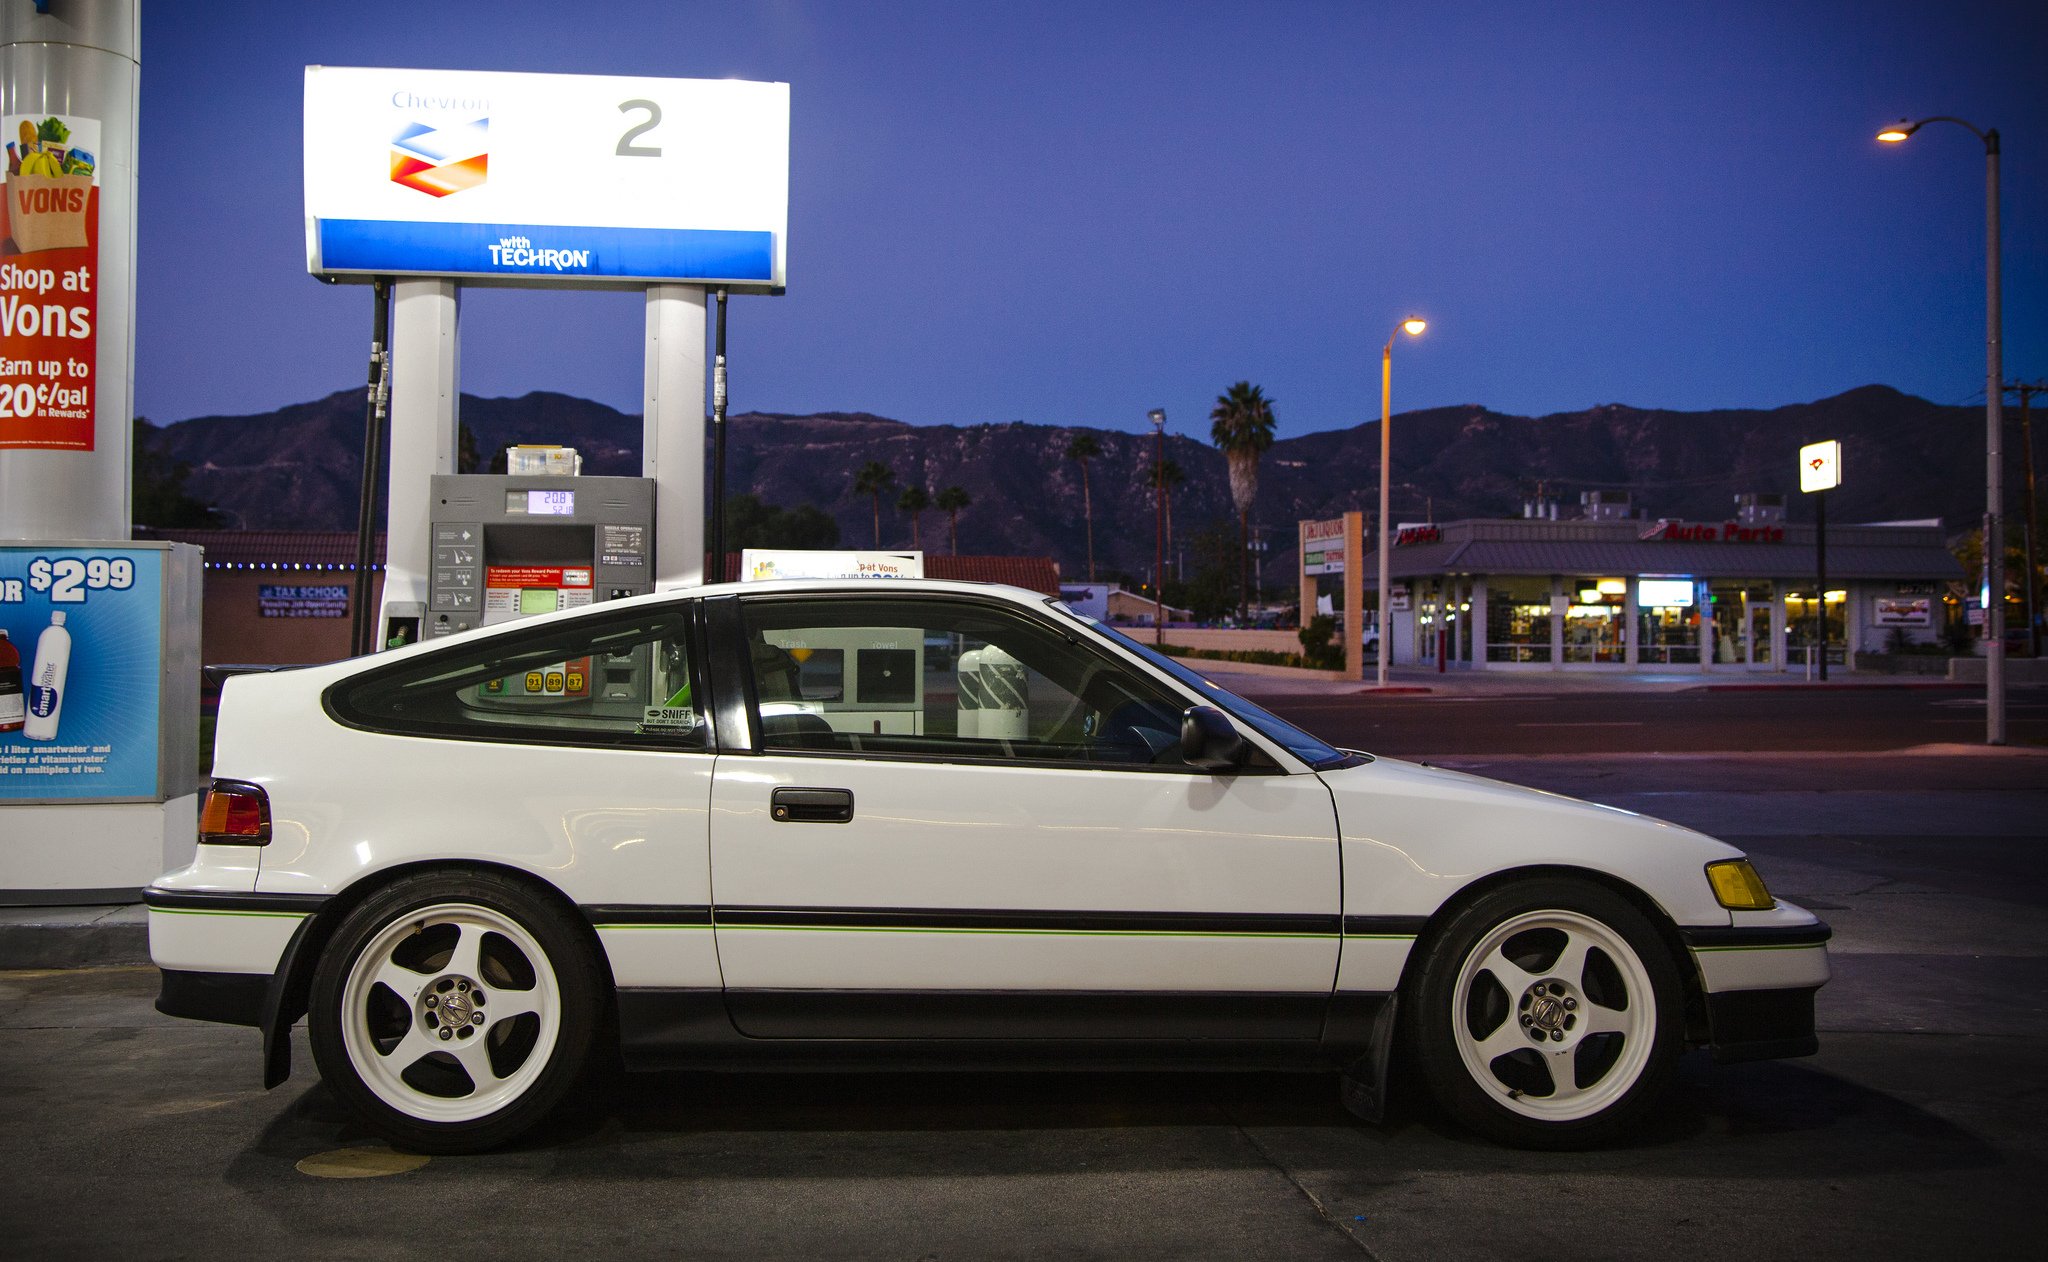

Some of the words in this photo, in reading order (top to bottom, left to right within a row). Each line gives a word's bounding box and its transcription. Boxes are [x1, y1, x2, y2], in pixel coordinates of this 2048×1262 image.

[392, 90, 490, 111] Chevron
[616, 99, 662, 157] 2
[18, 187, 84, 215] VONS
[500, 236, 530, 249] with
[488, 245, 588, 271] TECHRON
[0, 263, 55, 295] Shop
[62, 266, 90, 292] at
[0, 295, 91, 339] Vons
[0, 357, 32, 376] Earn
[38, 360, 62, 380] up
[67, 357, 89, 378] to
[37, 407, 46, 417] in
[1664, 523, 1717, 540] Auto
[1724, 523, 1784, 541] Parts
[878, 564, 898, 573] Vons
[275, 586, 297, 597] TAX
[300, 586, 347, 598] SCHOOL
[780, 639, 807, 649] Trash
[528, 678, 540, 686] 91
[548, 678, 560, 686] 89
[568, 678, 581, 686] 87
[662, 709, 691, 719] SNIFF
[11, 745, 30, 754] liter
[92, 744, 111, 753] and
[29, 755, 39, 764] of
[25, 765, 69, 776] multiples
[71, 765, 82, 774] of
[84, 765, 105, 774] two.
